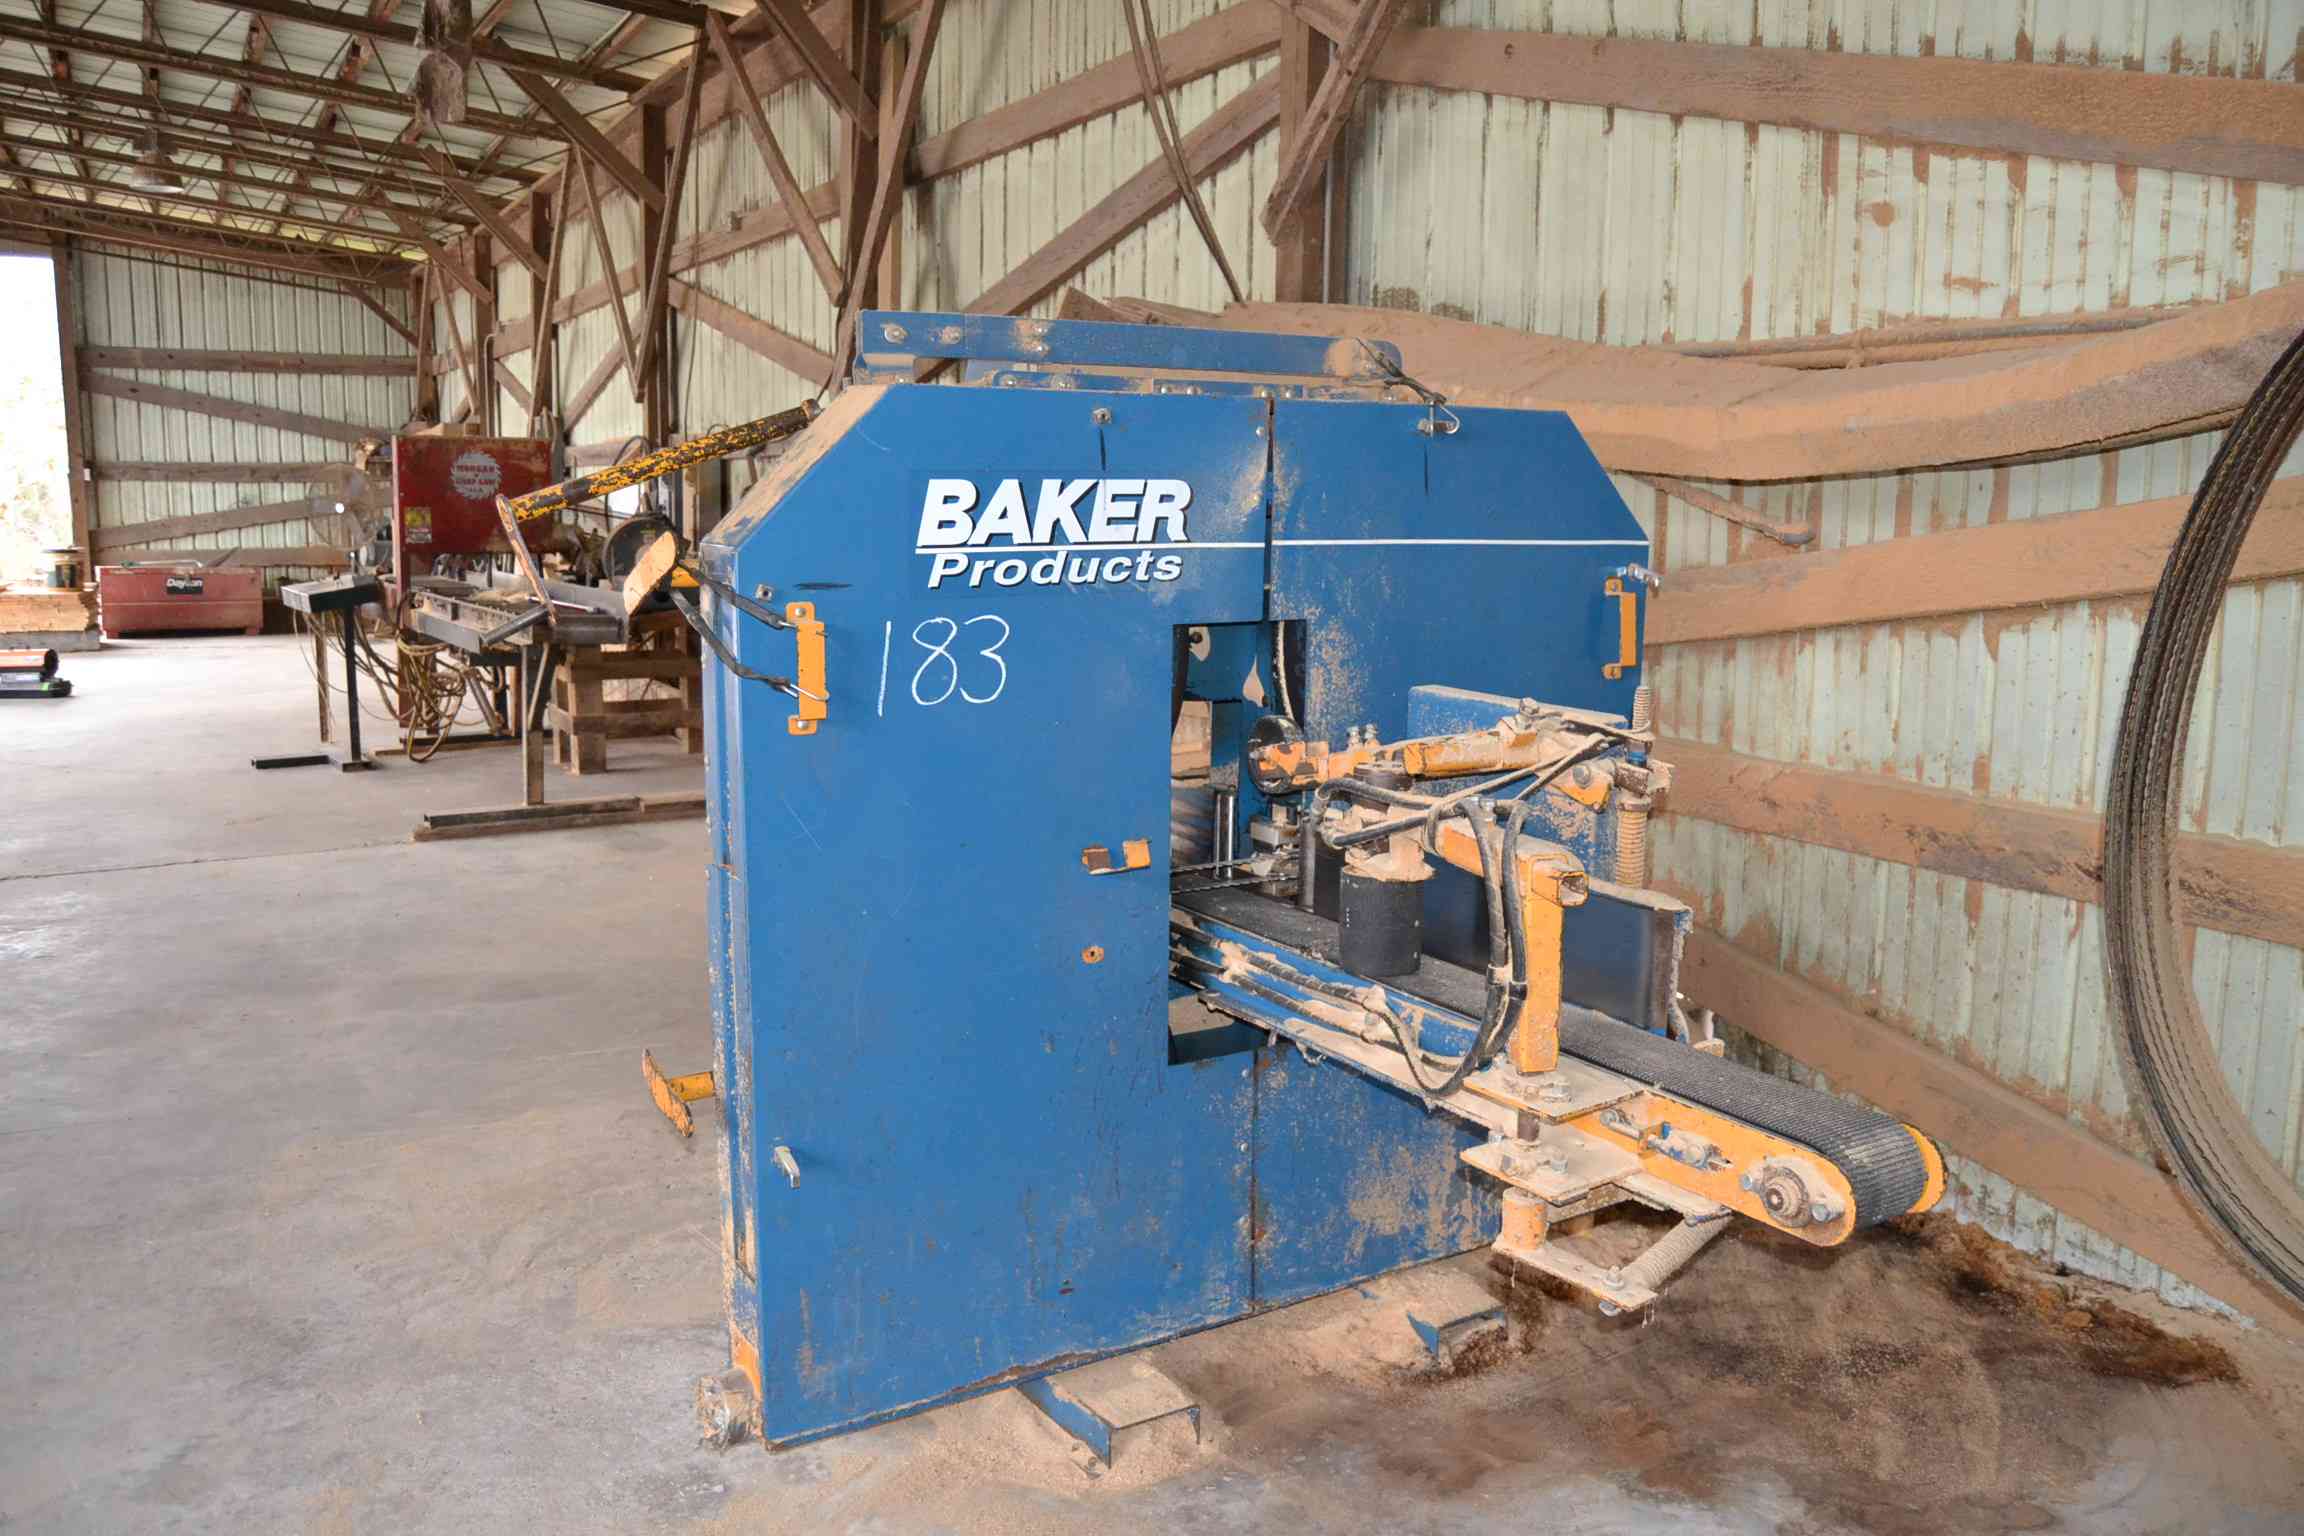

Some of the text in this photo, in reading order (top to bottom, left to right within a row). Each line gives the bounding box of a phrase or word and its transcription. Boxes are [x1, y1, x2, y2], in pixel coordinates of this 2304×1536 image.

[916, 479, 1193, 547] BAKER
[927, 550, 1183, 589] Products
[877, 614, 1010, 717] 183
